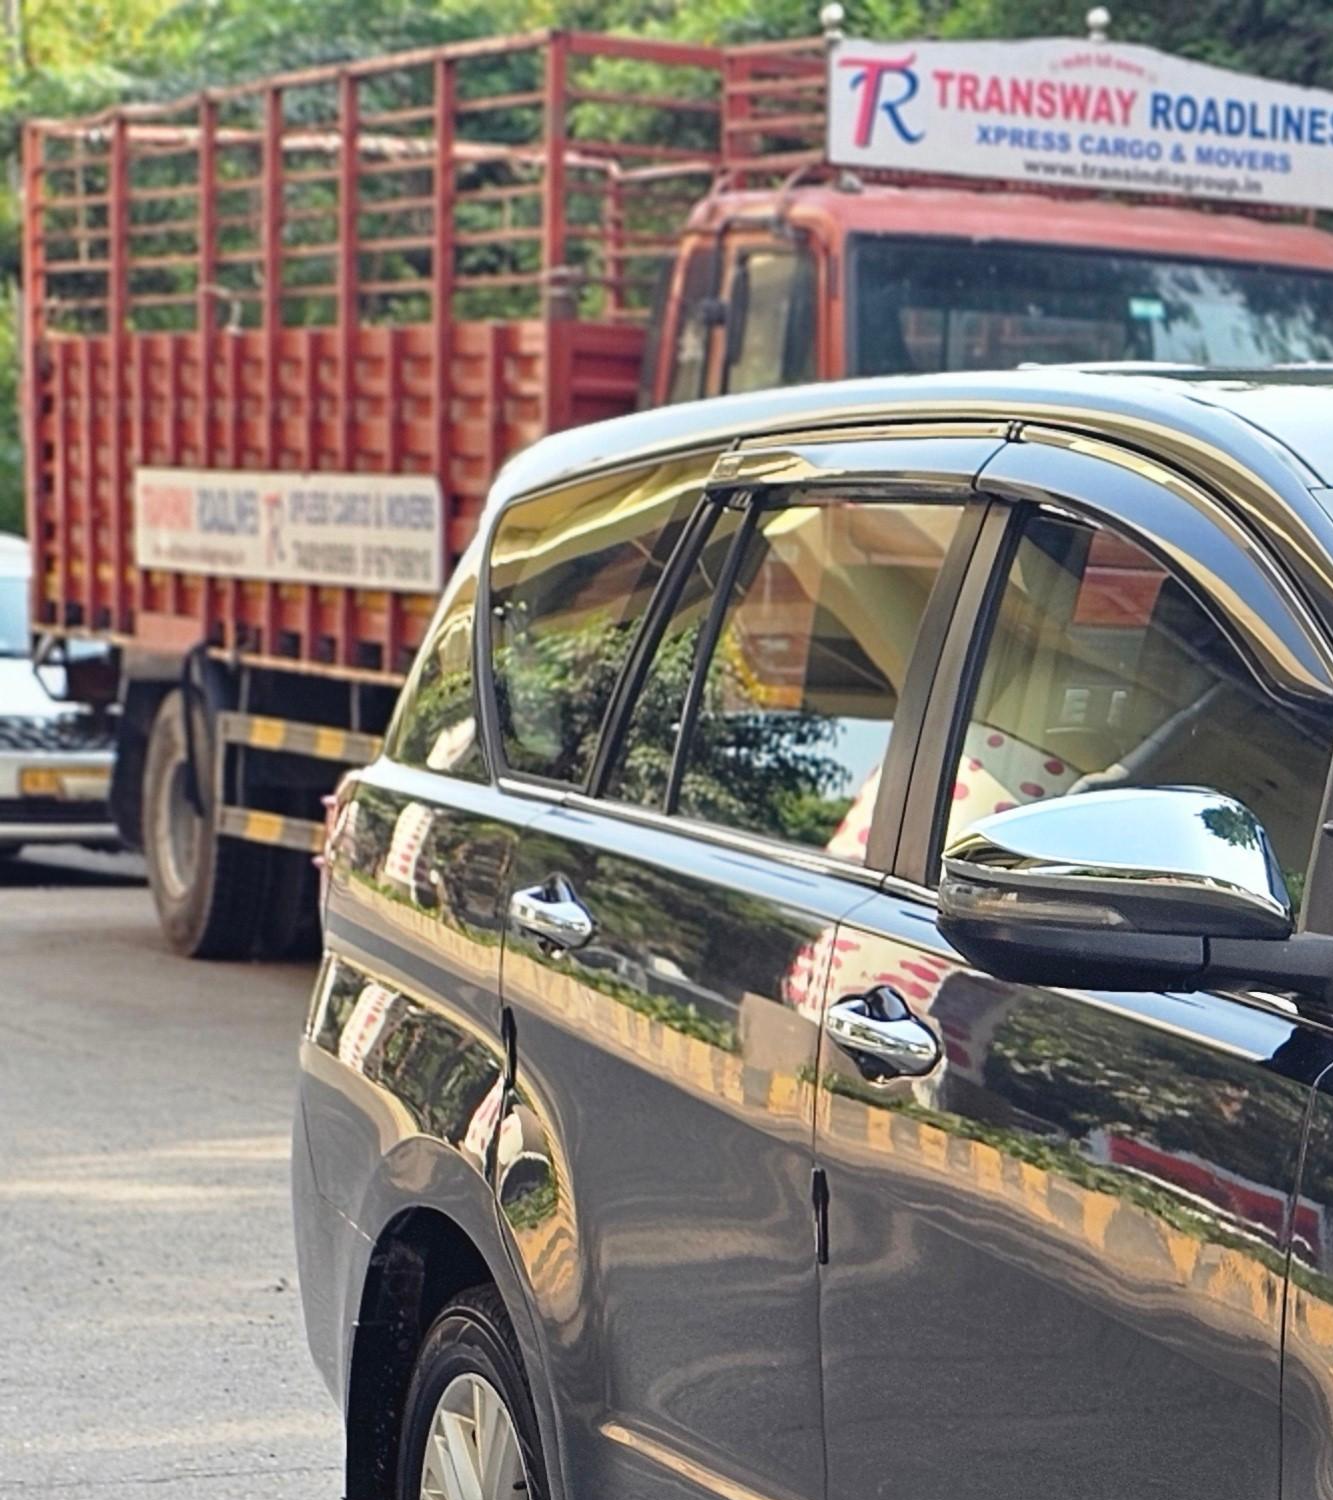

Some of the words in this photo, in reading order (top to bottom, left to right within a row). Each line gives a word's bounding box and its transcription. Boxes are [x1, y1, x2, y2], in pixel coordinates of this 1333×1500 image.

[932, 69, 1138, 128] TRANSWAY
[975, 125, 1072, 152] XPRESS
[1078, 135, 1163, 161] CARGO
[1170, 143, 1187, 163] &
[1194, 146, 1293, 174] MOVERS
[1023, 158, 1263, 195] www.transindiagroup.in
